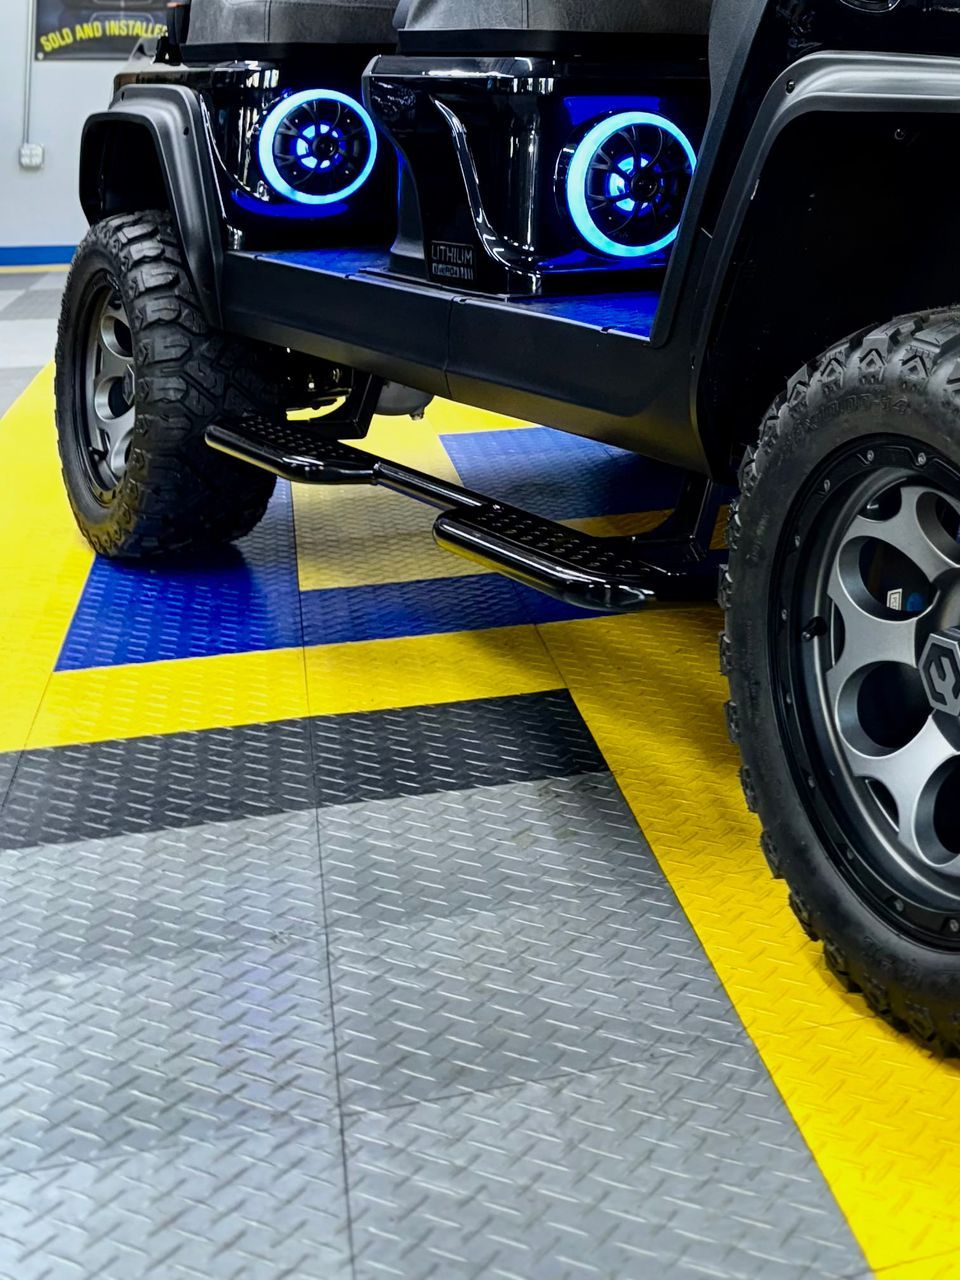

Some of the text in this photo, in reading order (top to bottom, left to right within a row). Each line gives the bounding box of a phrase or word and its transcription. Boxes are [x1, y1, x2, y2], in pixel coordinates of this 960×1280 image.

[40, 27, 73, 52] SOLD
[75, 21, 102, 40] AND
[431, 245, 473, 265] LITHIUM
